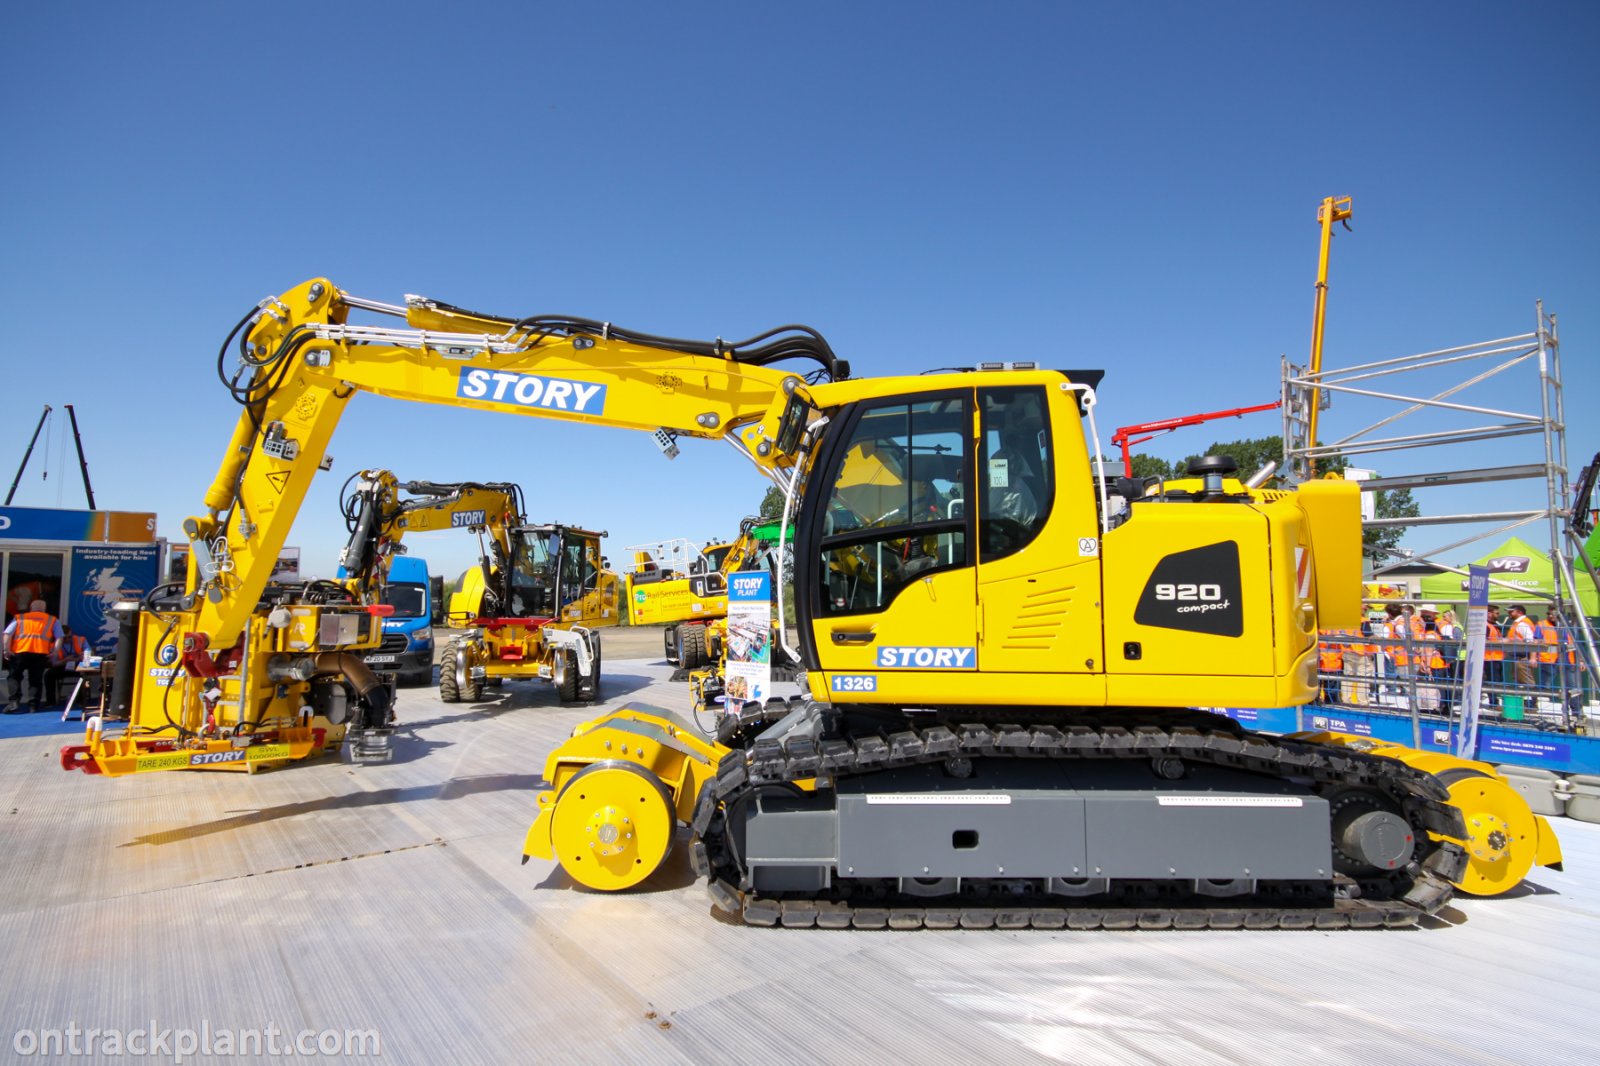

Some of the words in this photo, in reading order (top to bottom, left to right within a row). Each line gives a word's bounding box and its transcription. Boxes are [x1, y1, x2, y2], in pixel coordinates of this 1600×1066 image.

[462, 369, 602, 411] STORY
[452, 510, 485, 527] STORY
[75, 548, 138, 556] Industry-leading
[734, 577, 763, 590] STORY
[737, 589, 758, 597] PLANT
[1155, 584, 1221, 601] 920
[1177, 599, 1230, 613] compact
[880, 647, 972, 667] STORY
[834, 676, 874, 691] 1326
[1330, 720, 1346, 728] TPA
[138, 758, 157, 769] TARE
[158, 757, 172, 767] 240
[172, 756, 188, 767] KGS
[191, 750, 245, 765] STORY
